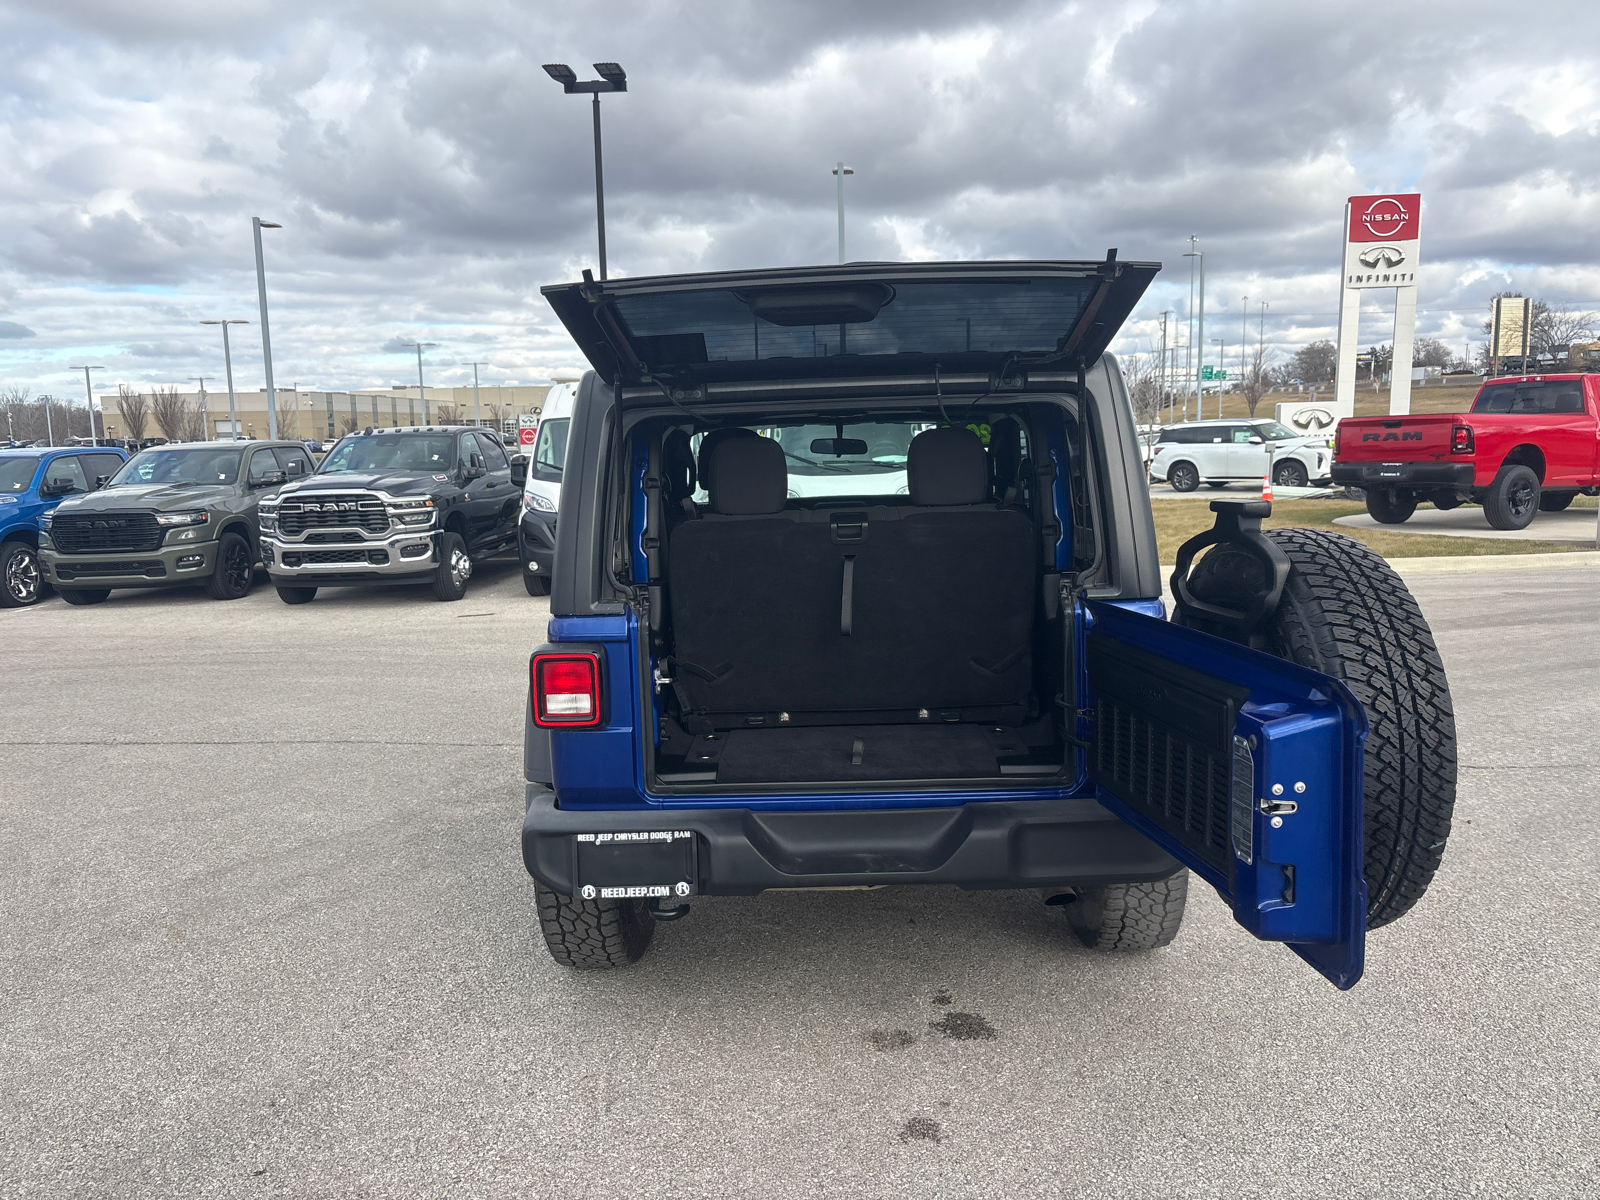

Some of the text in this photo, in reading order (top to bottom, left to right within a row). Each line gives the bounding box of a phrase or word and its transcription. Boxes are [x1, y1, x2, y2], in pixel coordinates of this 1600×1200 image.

[1362, 213, 1409, 221] NISSAN
[1348, 273, 1414, 283] INFINITI
[1362, 432, 1422, 442] RAM
[303, 502, 356, 512] RAM
[76, 520, 127, 529] RAM
[577, 834, 595, 842] REED
[597, 833, 613, 841] JEEP
[614, 832, 649, 841] CHRYSLER
[650, 831, 673, 839] DODGE
[601, 886, 670, 898] REEDJEEP.COM
